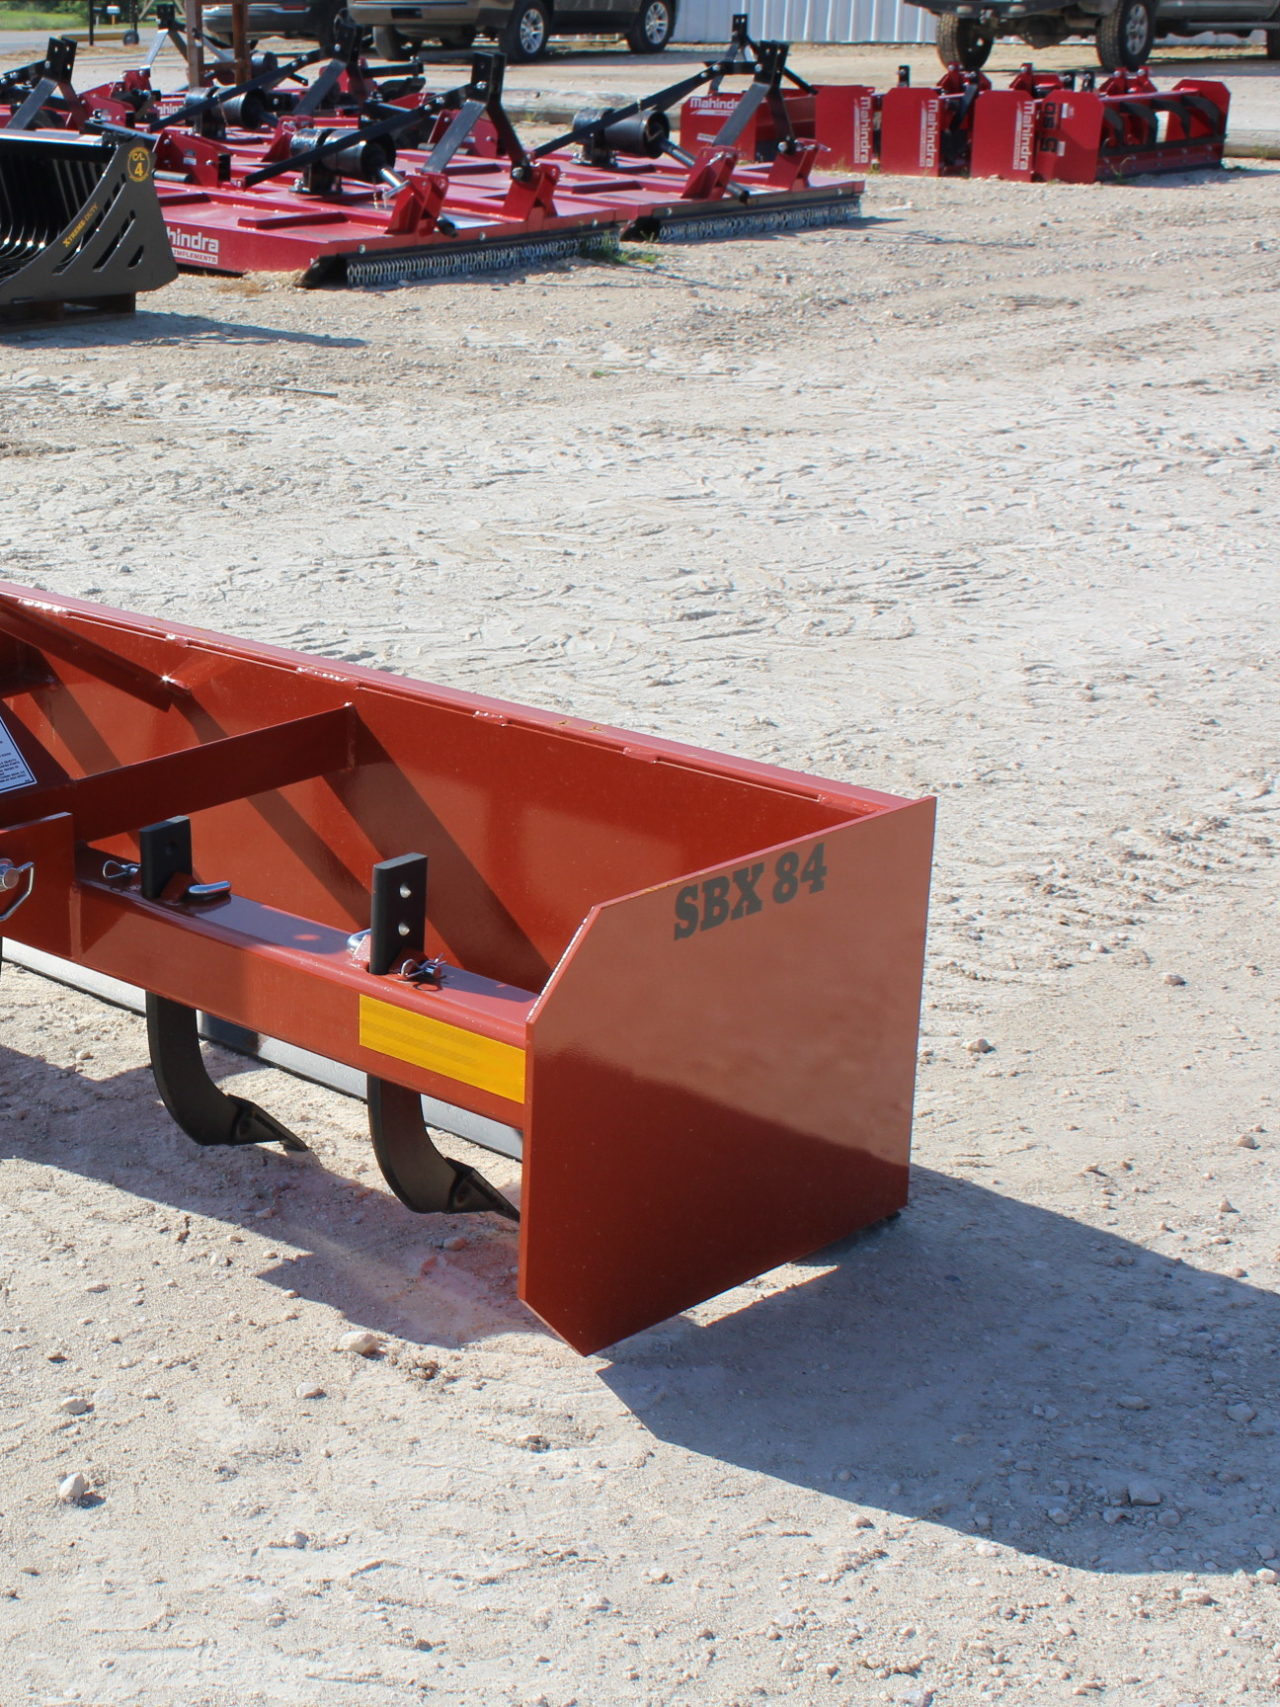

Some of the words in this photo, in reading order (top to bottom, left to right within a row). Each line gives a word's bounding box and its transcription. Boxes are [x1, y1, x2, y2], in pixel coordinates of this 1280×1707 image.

[690, 97, 740, 110] Mahindr
[860, 96, 871, 163] Mahindra
[926, 99, 939, 168] Mahindra
[1020, 101, 1036, 170] Mahindra
[134, 162, 144, 177] 4
[166, 226, 219, 253] hindra
[673, 862, 764, 941] SBX
[772, 843, 828, 904] 84
